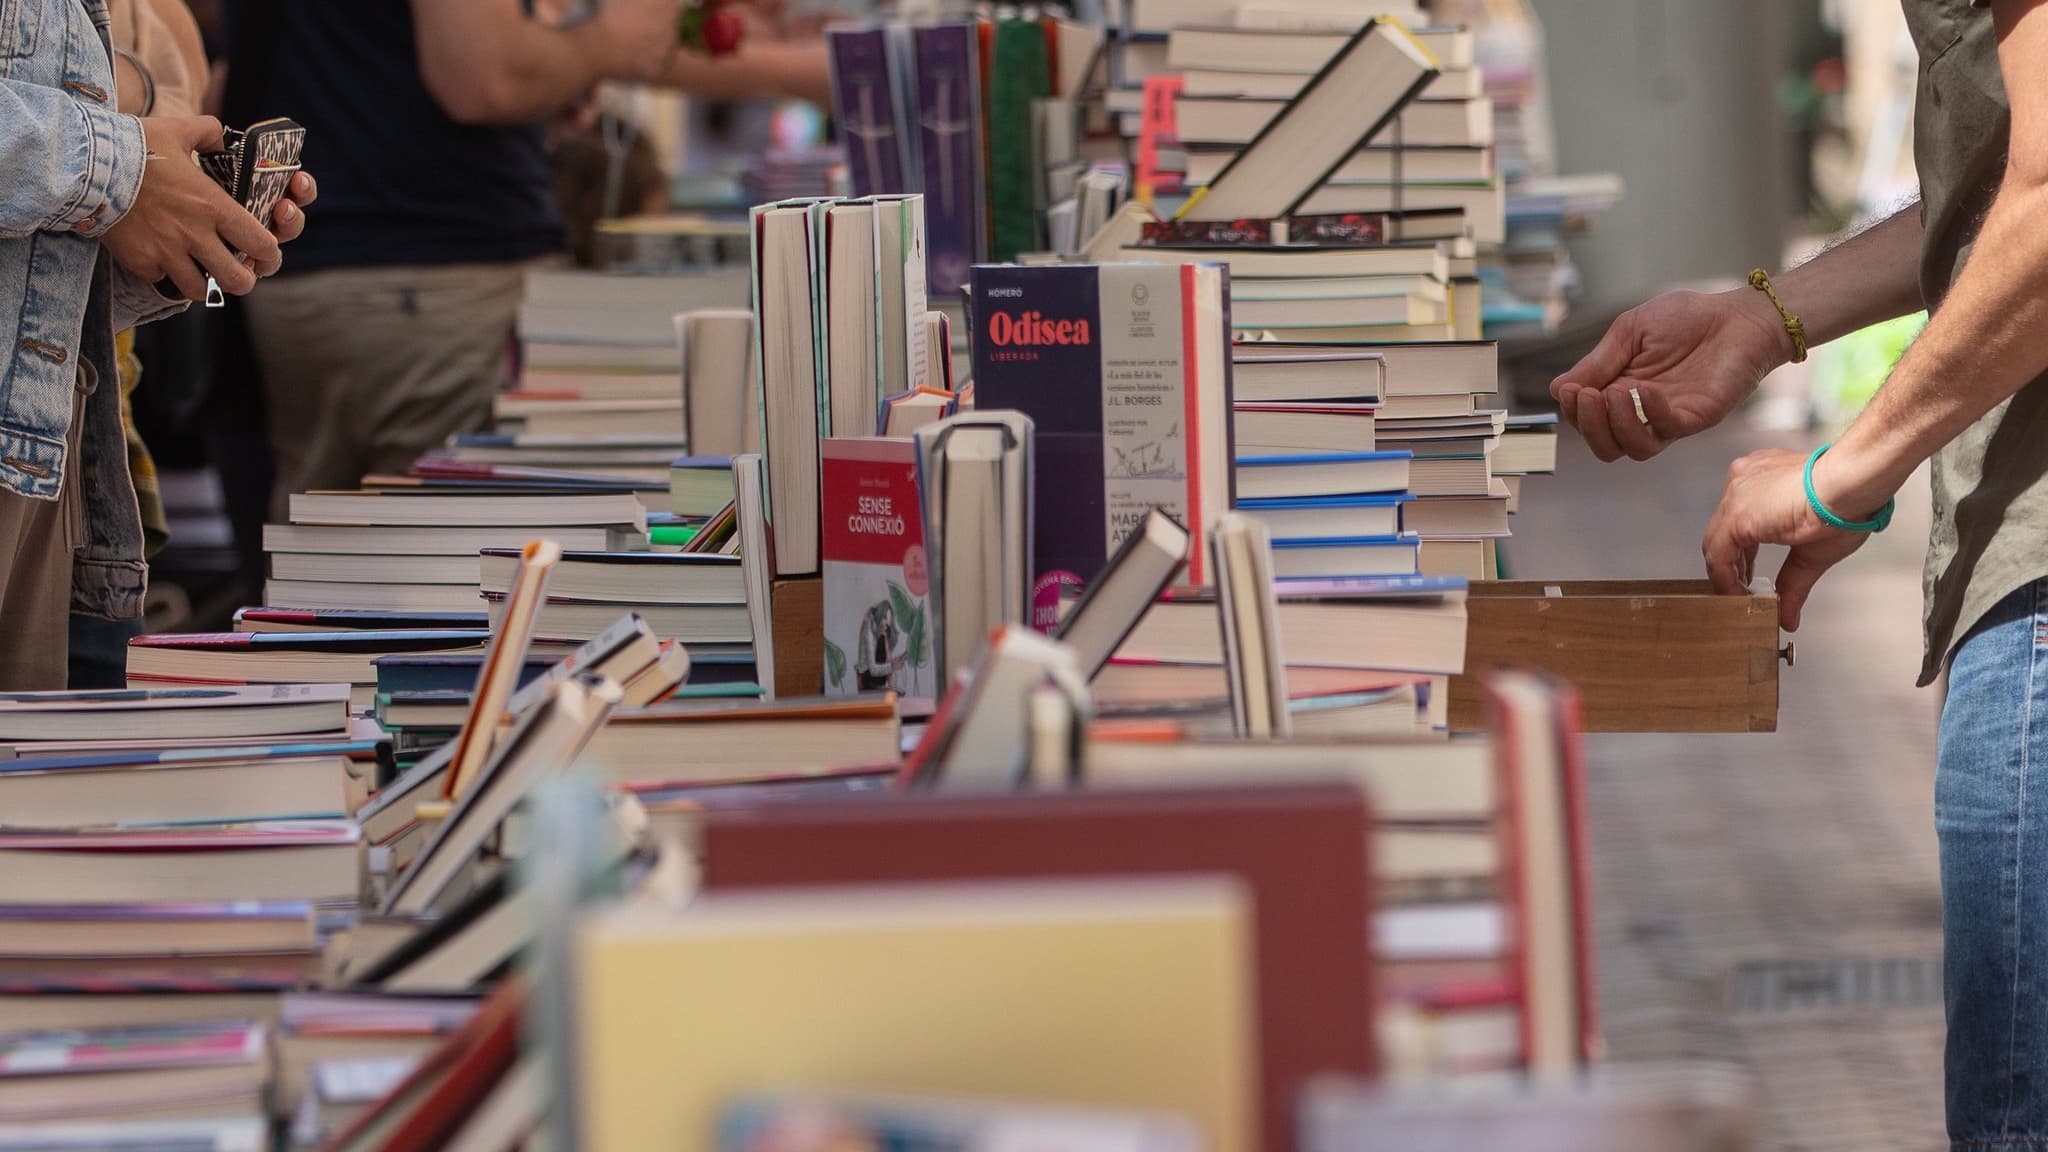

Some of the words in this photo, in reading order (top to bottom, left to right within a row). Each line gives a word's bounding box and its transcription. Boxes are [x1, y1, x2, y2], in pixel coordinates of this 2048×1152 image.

[988, 288, 1023, 298] HOMERO
[989, 311, 1090, 346] Odisea
[1125, 396, 1162, 406] BORGES
[858, 496, 892, 516] SENSE
[848, 514, 905, 536] CONNEXIÓ
